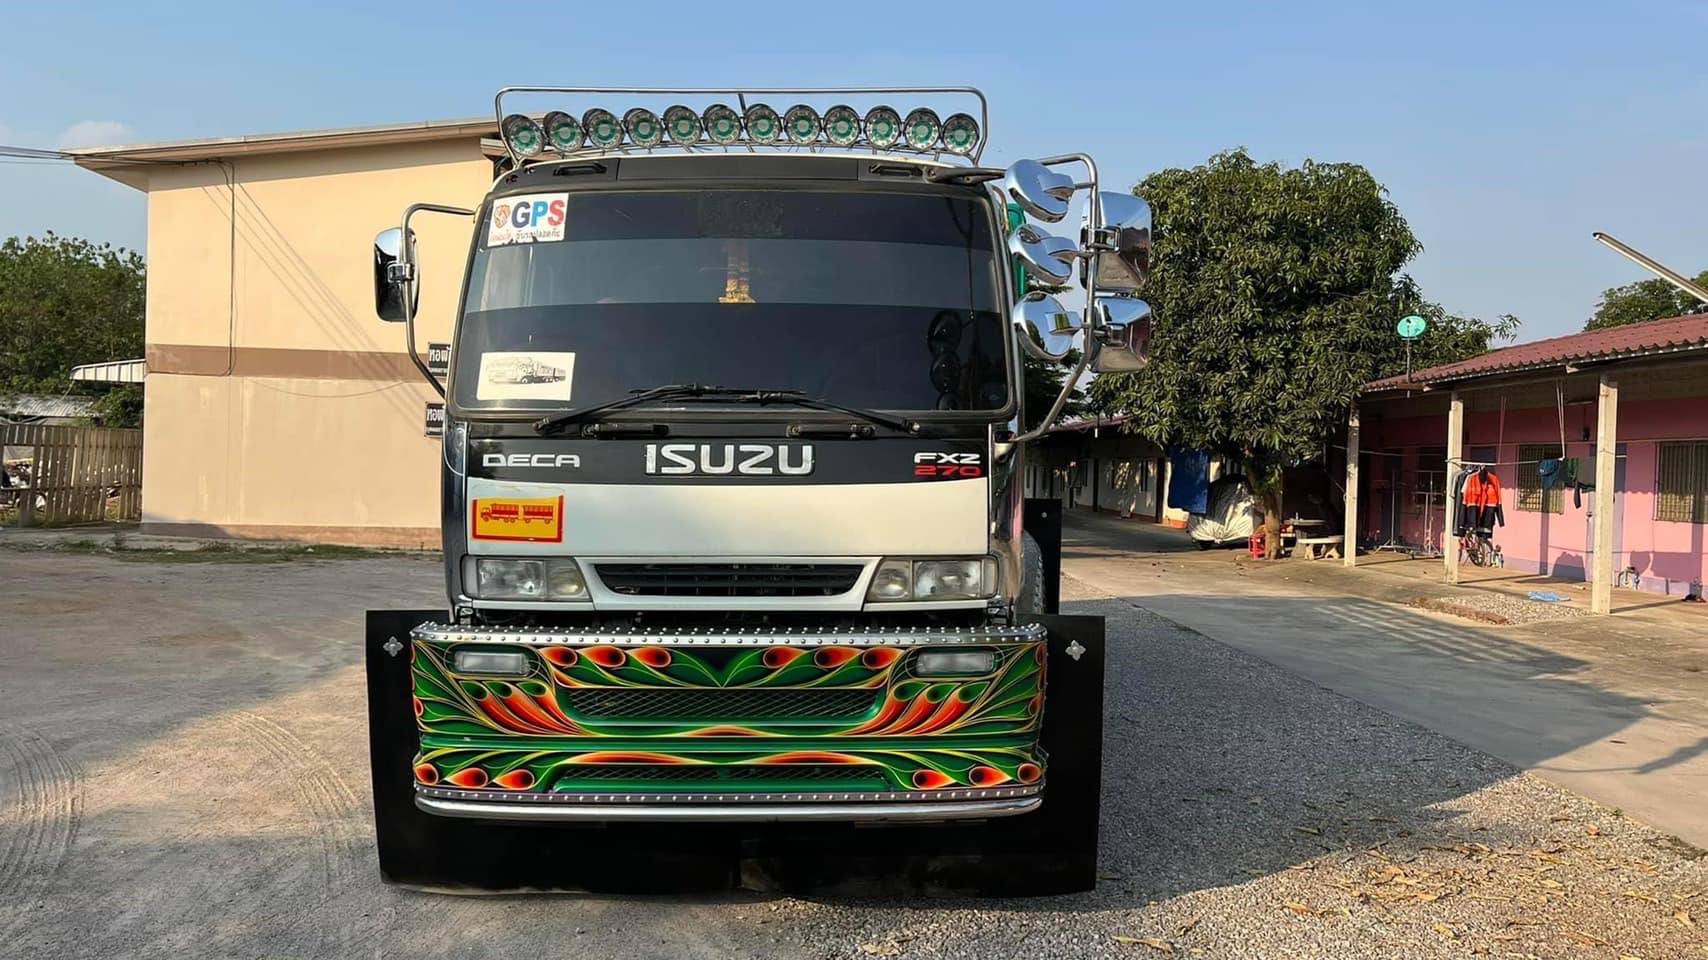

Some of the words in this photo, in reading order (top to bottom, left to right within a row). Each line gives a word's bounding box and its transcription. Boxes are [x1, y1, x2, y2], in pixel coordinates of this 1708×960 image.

[511, 200, 565, 228] GPS
[482, 453, 581, 468] DECA
[645, 444, 813, 475] ISUZU
[913, 452, 981, 464] FXZ
[914, 465, 982, 477] 270
